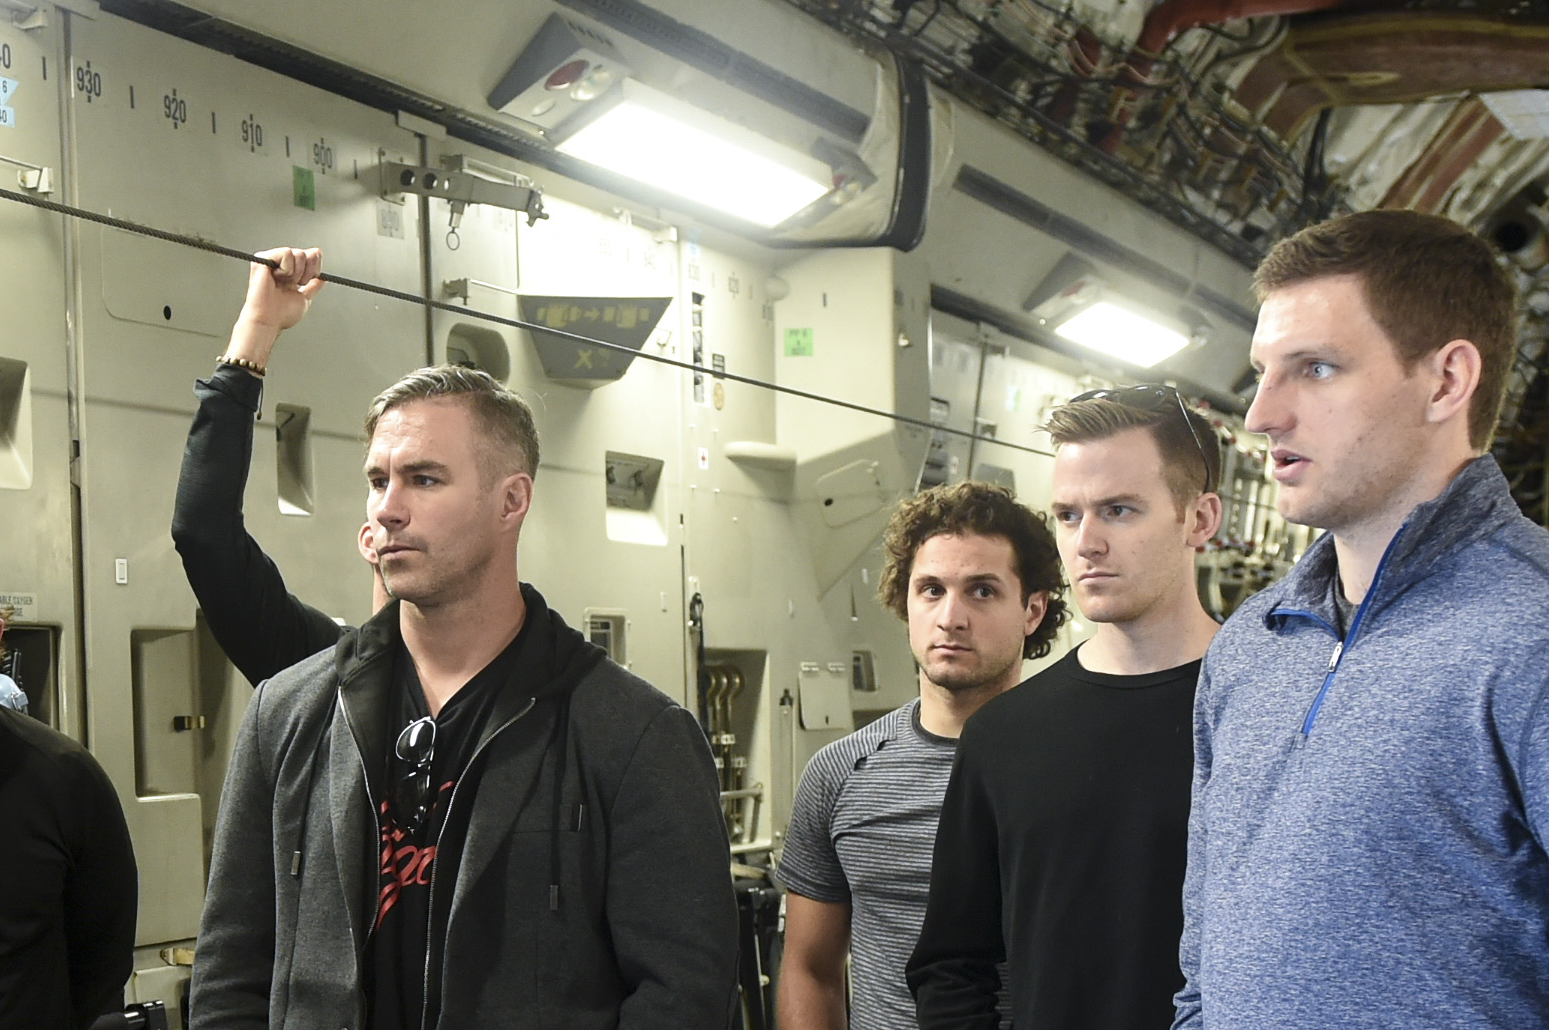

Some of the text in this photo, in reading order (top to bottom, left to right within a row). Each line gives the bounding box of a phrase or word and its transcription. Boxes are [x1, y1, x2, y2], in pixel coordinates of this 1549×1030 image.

[2, 80, 8, 93] 6
[77, 66, 101, 97] 930
[163, 95, 187, 123] 920
[241, 119, 263, 147] 910
[313, 143, 333, 169] 900
